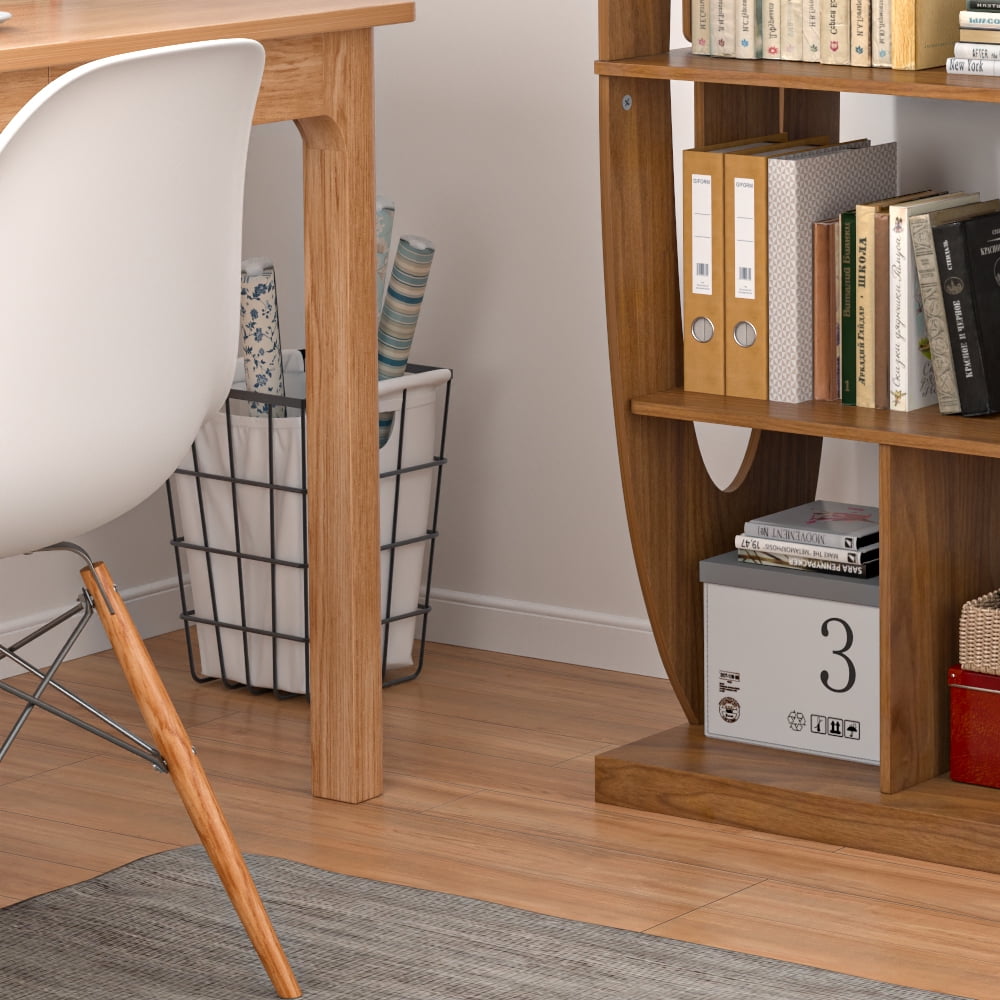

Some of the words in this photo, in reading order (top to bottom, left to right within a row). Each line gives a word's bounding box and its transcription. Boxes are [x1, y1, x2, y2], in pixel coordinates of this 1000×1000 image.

[949, 59, 965, 72] New
[967, 60, 984, 73] York
[858, 237, 867, 288] ШКОЛА
[952, 299, 964, 332] ЧЕРНОЕ
[961, 344, 974, 379] КРАСНОЕ
[772, 528, 824, 545] MOOVEMENT
[812, 550, 822, 558] THE
[824, 552, 839, 560] MAKE
[788, 558, 841, 572] PENNYPACKER
[842, 564, 863, 575] SARA
[819, 617, 856, 693] 3
